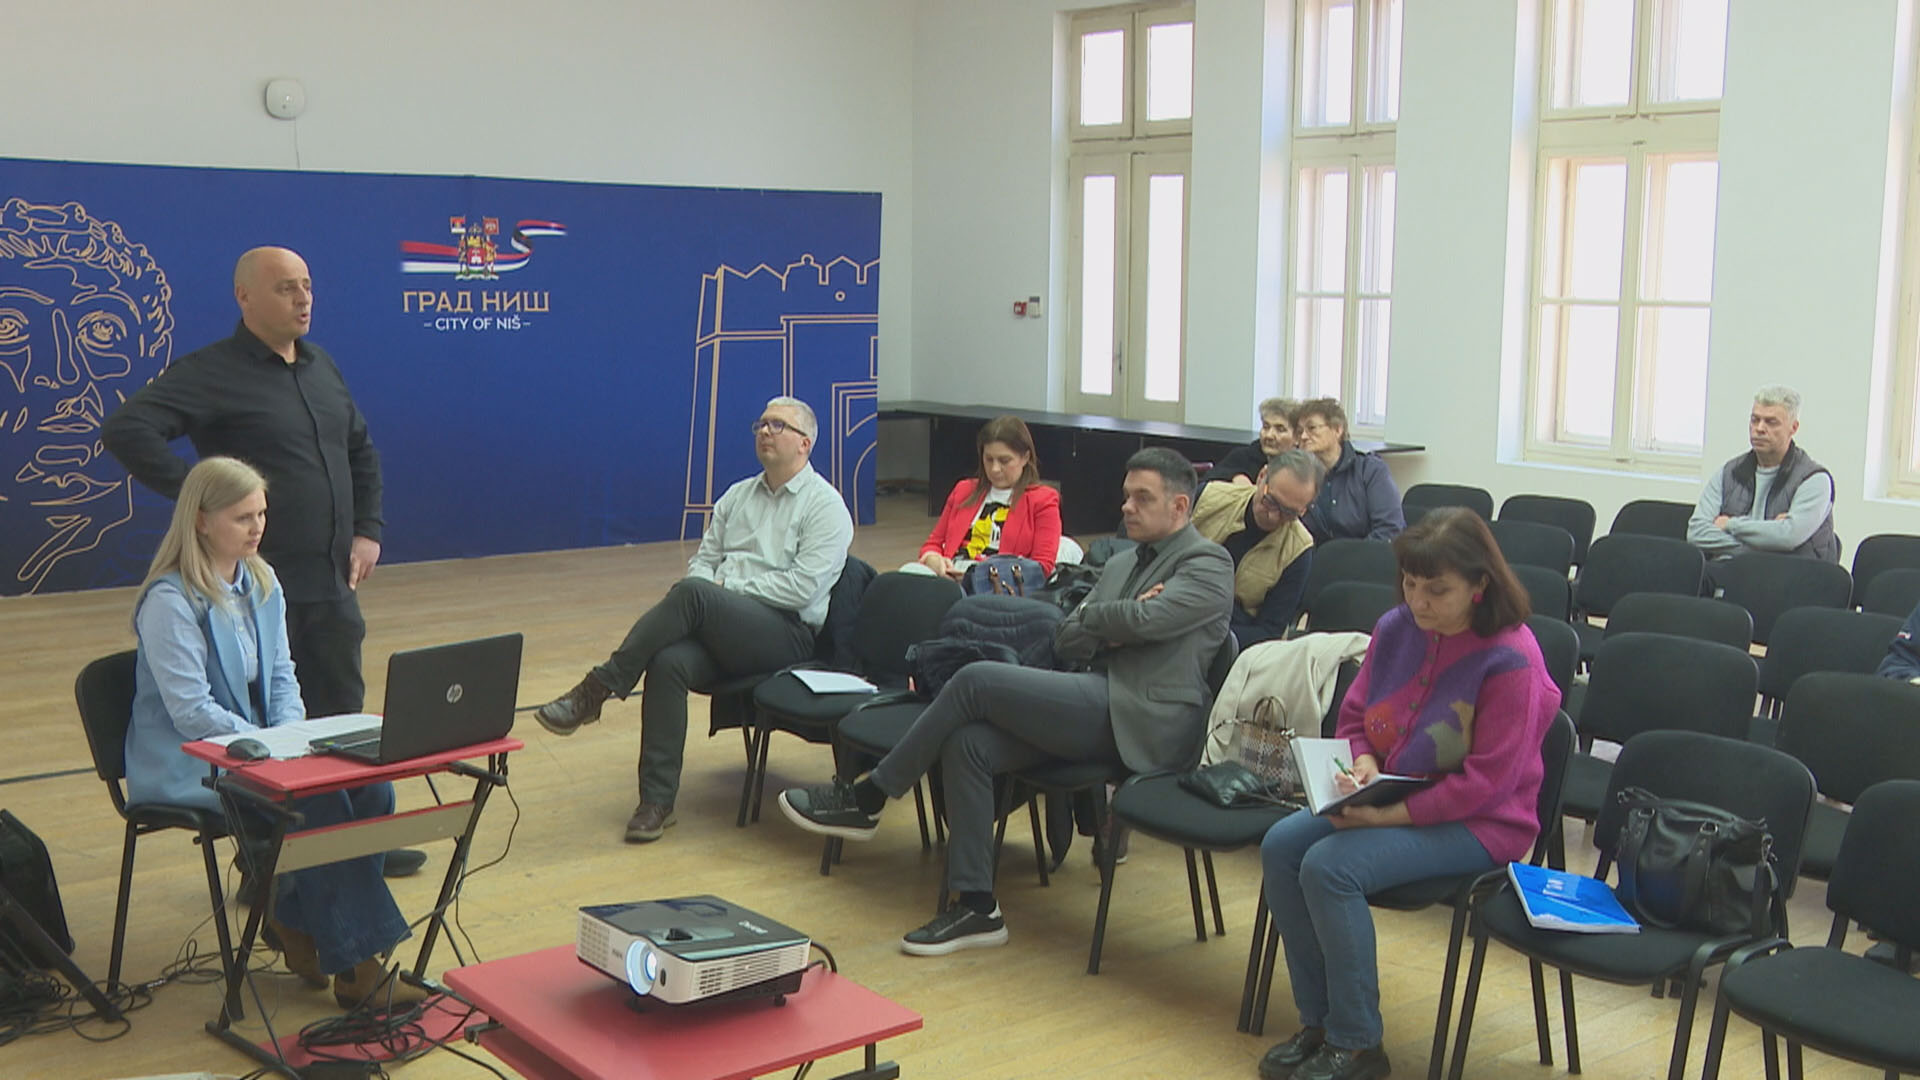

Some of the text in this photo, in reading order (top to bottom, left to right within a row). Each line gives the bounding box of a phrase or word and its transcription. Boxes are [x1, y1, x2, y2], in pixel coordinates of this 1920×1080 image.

[403, 291, 550, 313] ГРАД НИШ
[435, 314, 521, 331] CITY OF NIŠ
